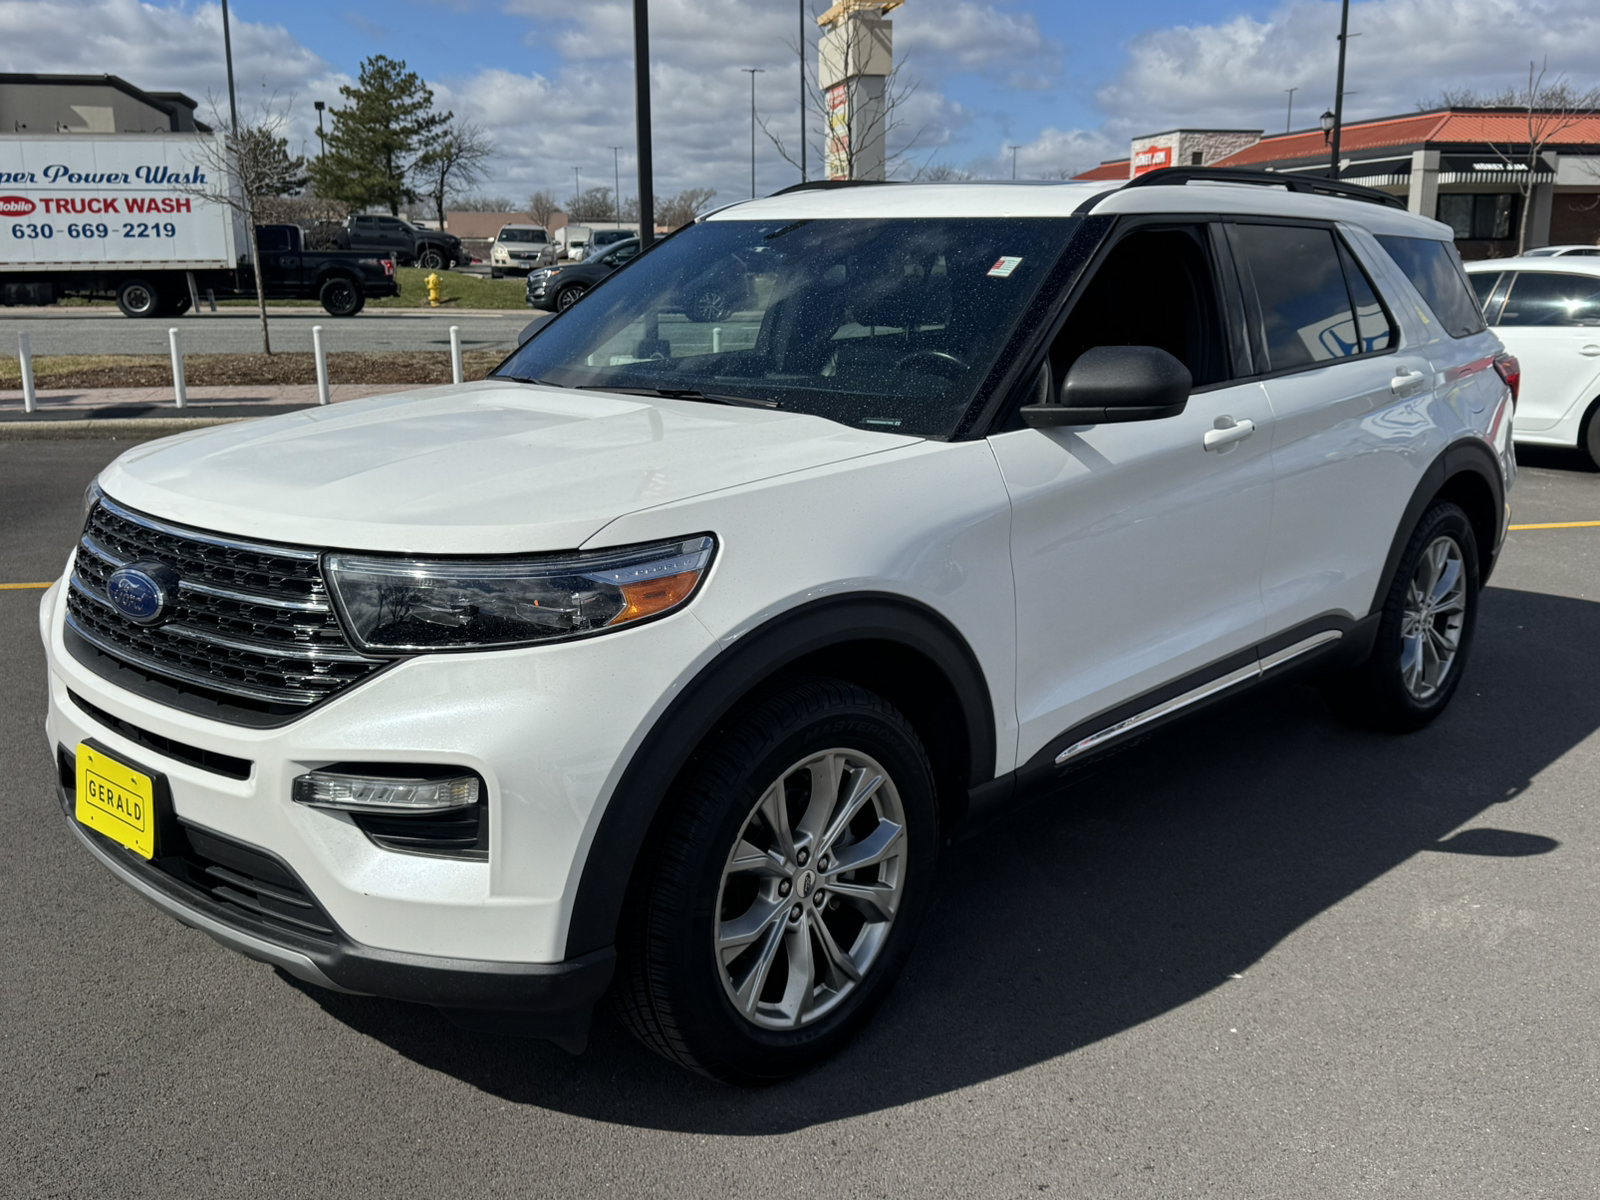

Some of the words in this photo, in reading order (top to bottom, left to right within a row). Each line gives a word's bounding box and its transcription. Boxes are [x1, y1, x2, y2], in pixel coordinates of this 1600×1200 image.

[42, 164, 132, 184] Power
[135, 165, 208, 184] Wash
[0, 200, 32, 212] obile
[39, 197, 121, 214] TRUCK
[124, 197, 192, 214] WASH
[88, 779, 142, 821] GERALD
